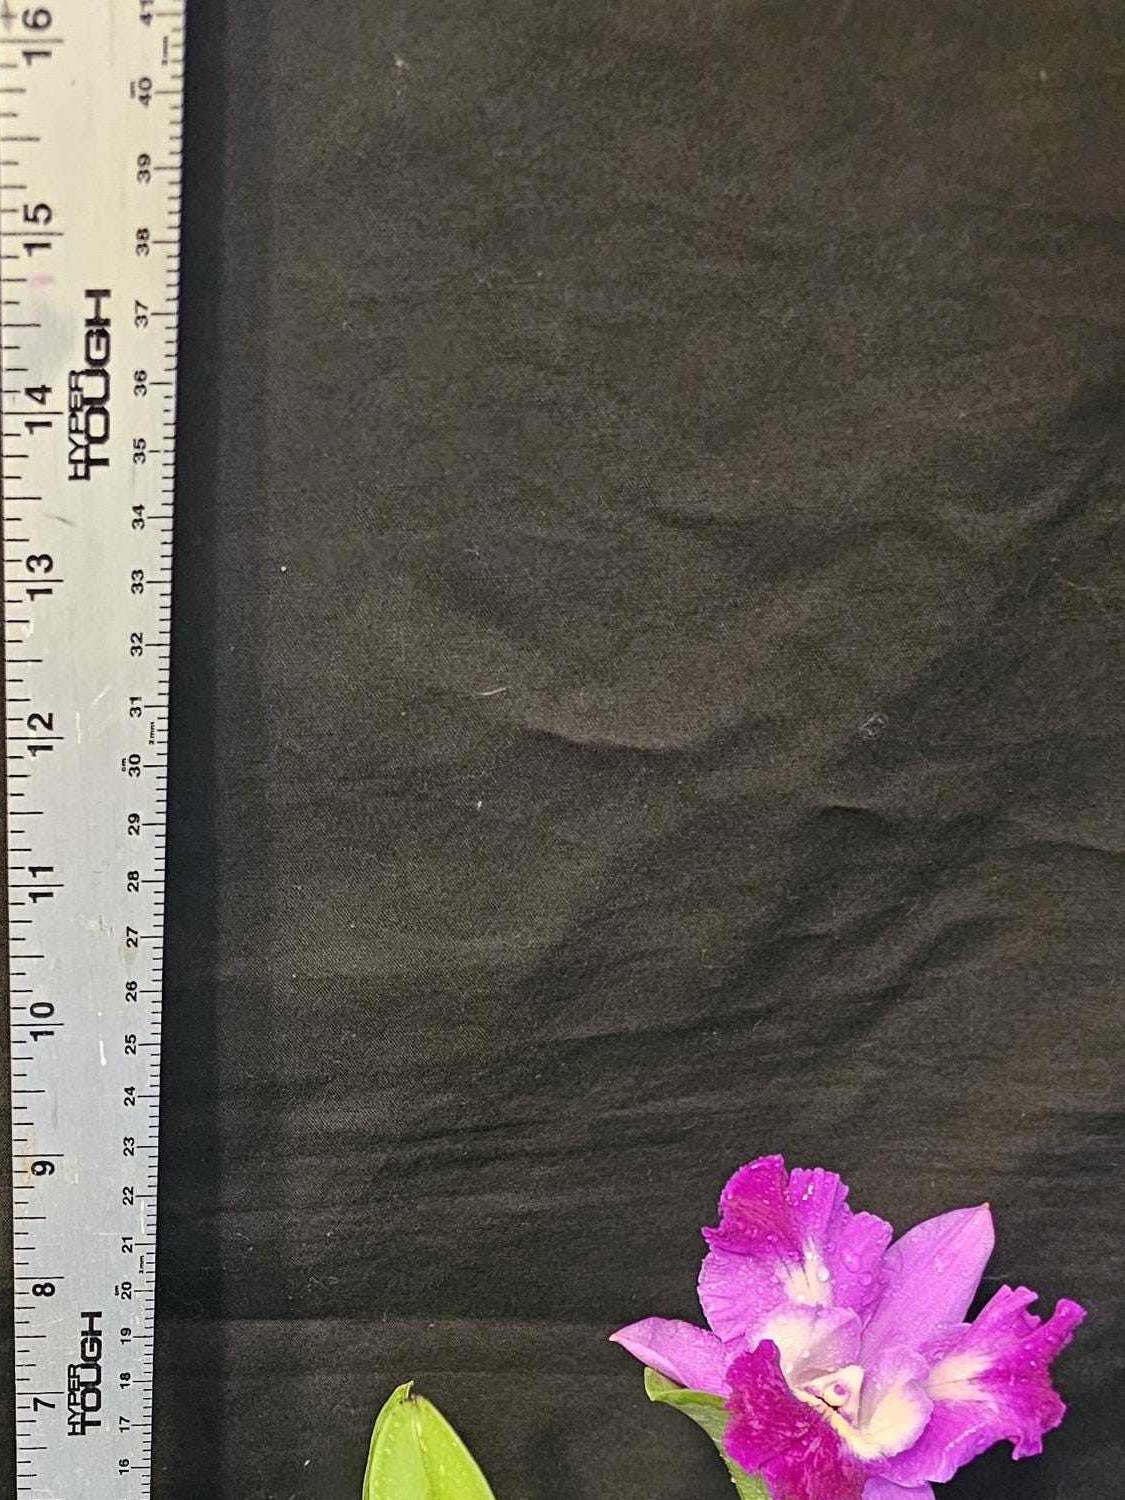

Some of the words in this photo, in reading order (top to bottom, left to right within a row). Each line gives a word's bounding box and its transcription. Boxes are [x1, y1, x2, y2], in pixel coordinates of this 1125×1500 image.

[22, 8, 52, 66] 16
[138, 77, 152, 107] 40
[137, 153, 151, 184] 39
[23, 203, 53, 257] 15
[136, 228, 150, 257] 38
[134, 300, 149, 328] 37
[84, 289, 111, 467] TOUGH
[134, 369, 148, 397] 36
[25, 385, 52, 434] 14
[68, 370, 86, 481] HYPER
[133, 438, 147, 464] 35
[131, 504, 145, 530] 34
[26, 554, 53, 601] 13
[131, 569, 144, 595] 33
[130, 632, 143, 657] 32
[129, 696, 142, 718] 31
[27, 713, 53, 757] 12
[128, 753, 141, 778] 30
[127, 813, 140, 836] 29
[28, 866, 54, 904] 11
[127, 870, 139, 893] 28
[126, 926, 139, 949] 27
[125, 980, 138, 1002] 26
[29, 1001, 55, 1042] 10
[125, 1034, 137, 1055] 25
[124, 1086, 136, 1107] 24
[123, 1136, 135, 1157] 23
[30, 1160, 56, 1177] 9
[122, 1186, 135, 1206] 22
[122, 1236, 134, 1254] 21
[31, 1282, 56, 1297] 8
[121, 1281, 132, 1300] 20
[120, 1327, 132, 1345] 19
[80, 1311, 103, 1427] TOUGH
[119, 1372, 131, 1389] 18
[33, 1397, 56, 1412] 7
[67, 1363, 83, 1436] HYPER
[119, 1416, 131, 1433] 17
[118, 1458, 130, 1476] 16
